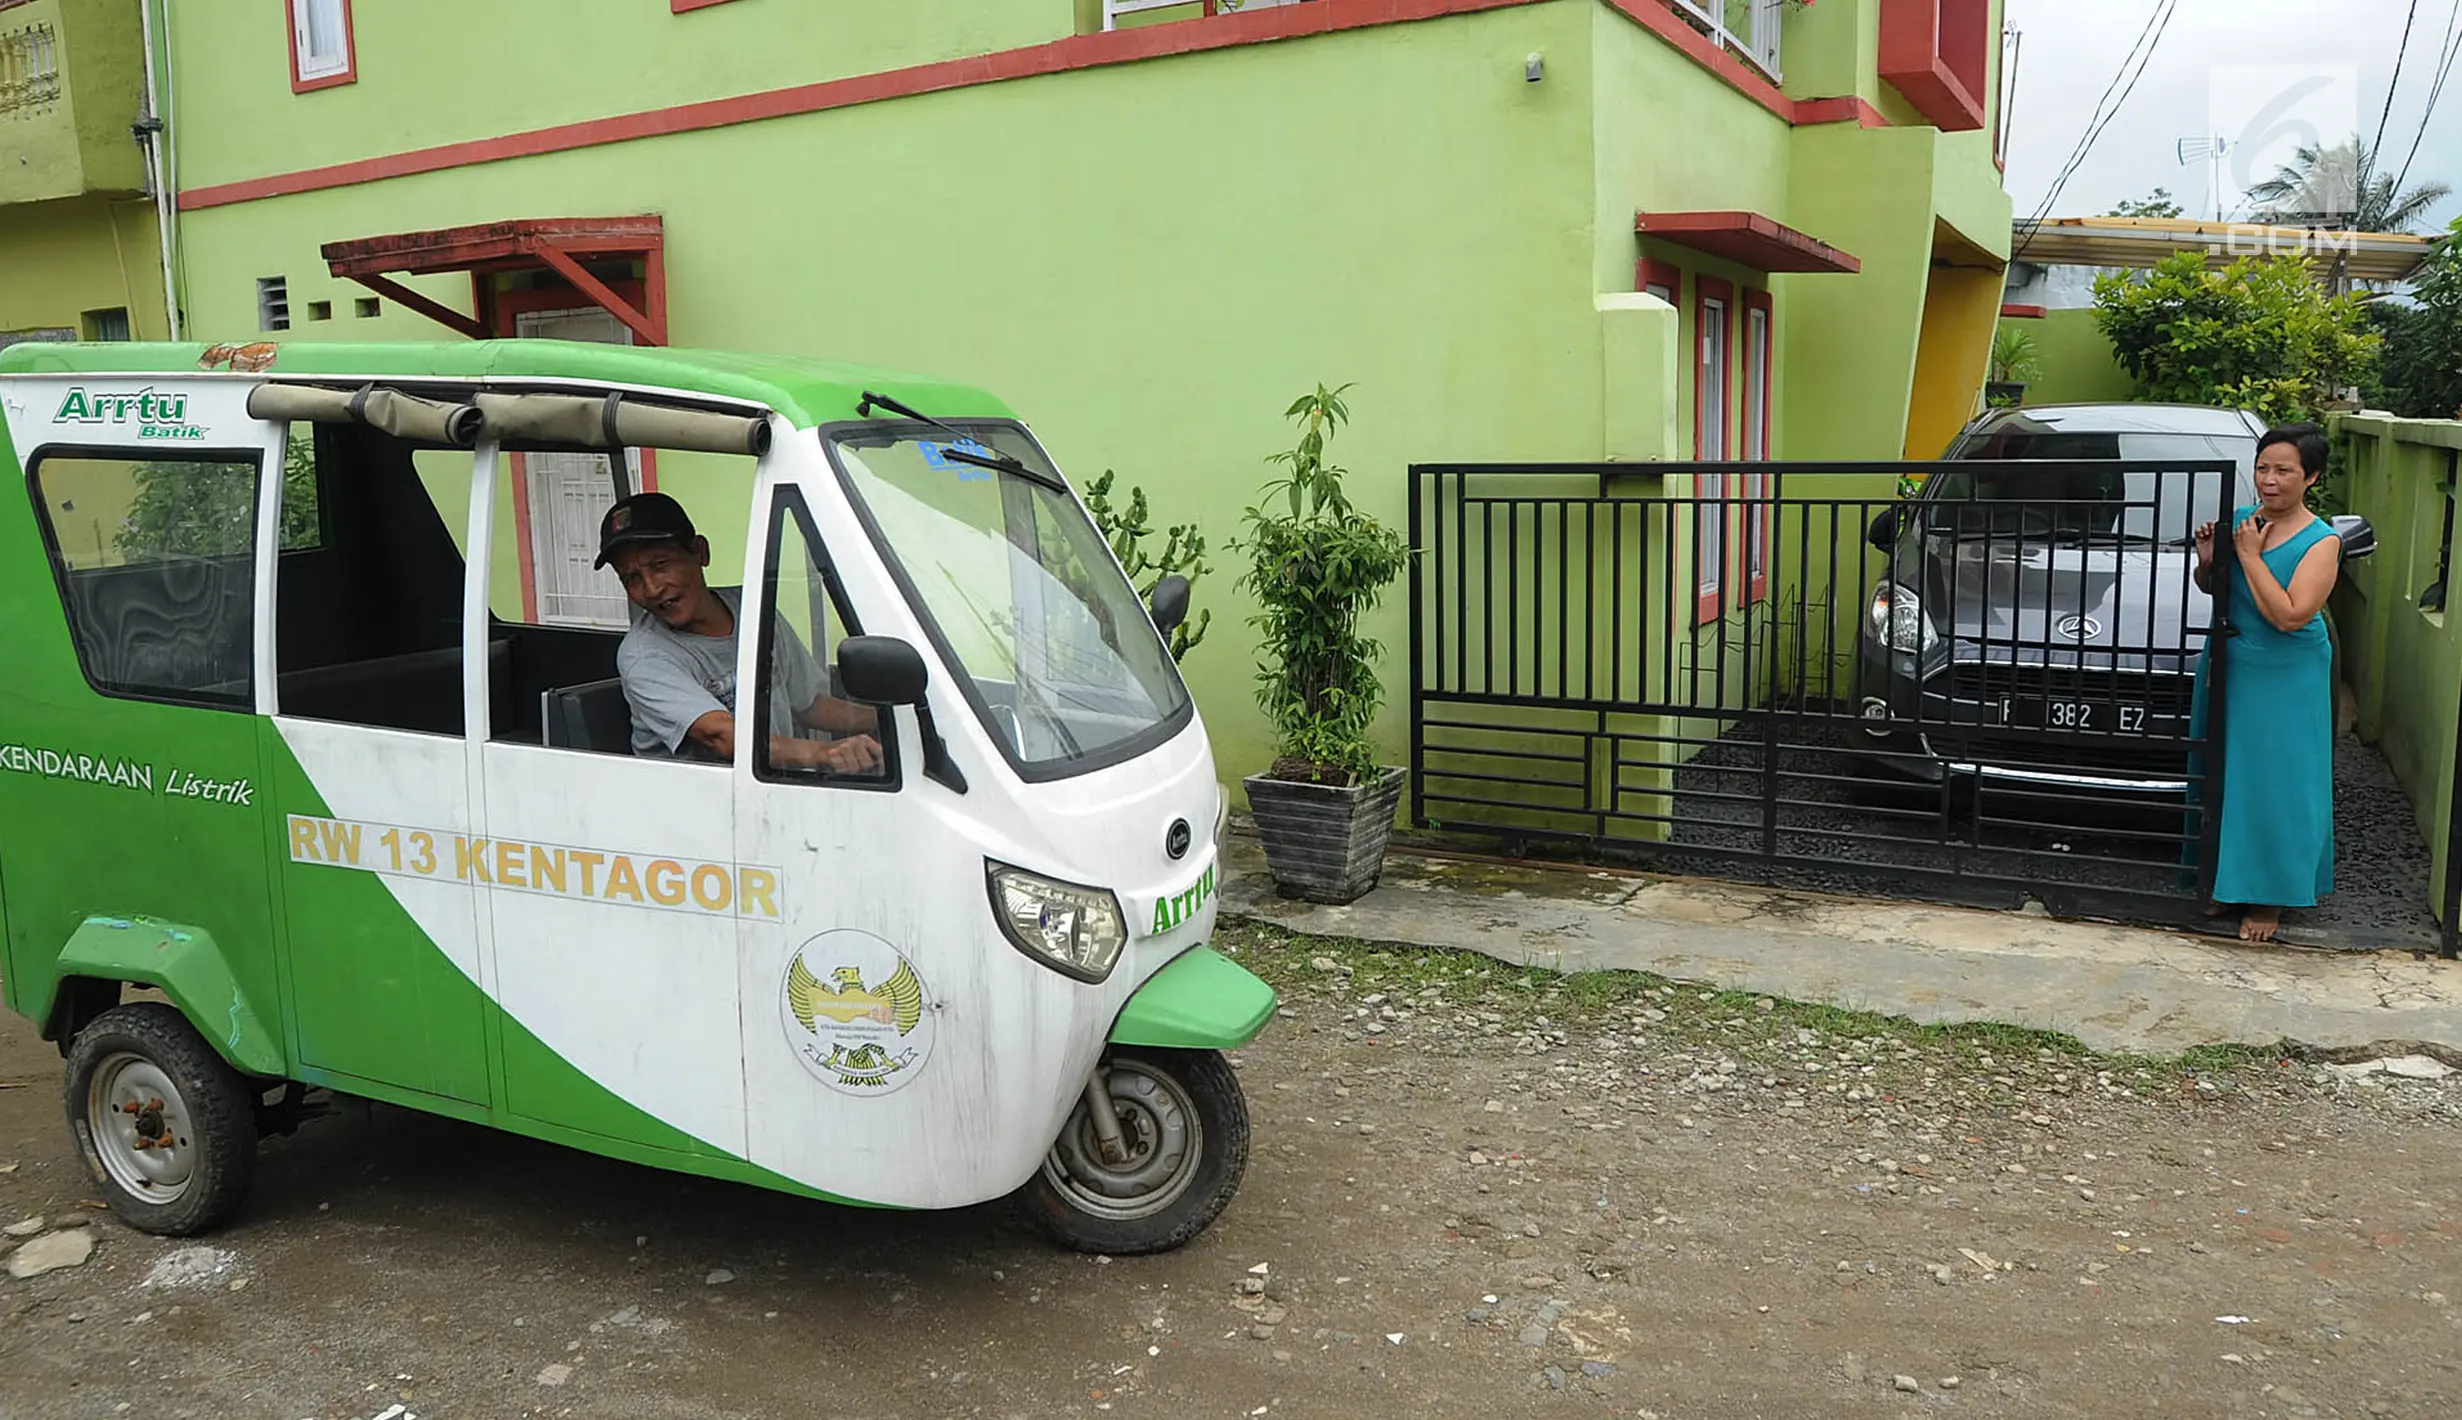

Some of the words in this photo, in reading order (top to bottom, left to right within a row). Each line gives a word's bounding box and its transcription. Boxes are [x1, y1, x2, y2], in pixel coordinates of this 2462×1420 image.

[53, 386, 188, 423] Arrtu
[139, 425, 207, 440] Batik
[2119, 706, 2145, 731] EZ
[0, 745, 152, 790] KENDARAAN
[164, 769, 254, 806] Listrik
[290, 817, 362, 867] RW
[380, 828, 437, 875] 13
[455, 836, 780, 918] KENTAGOR
[1152, 863, 1215, 935] Arrtu
